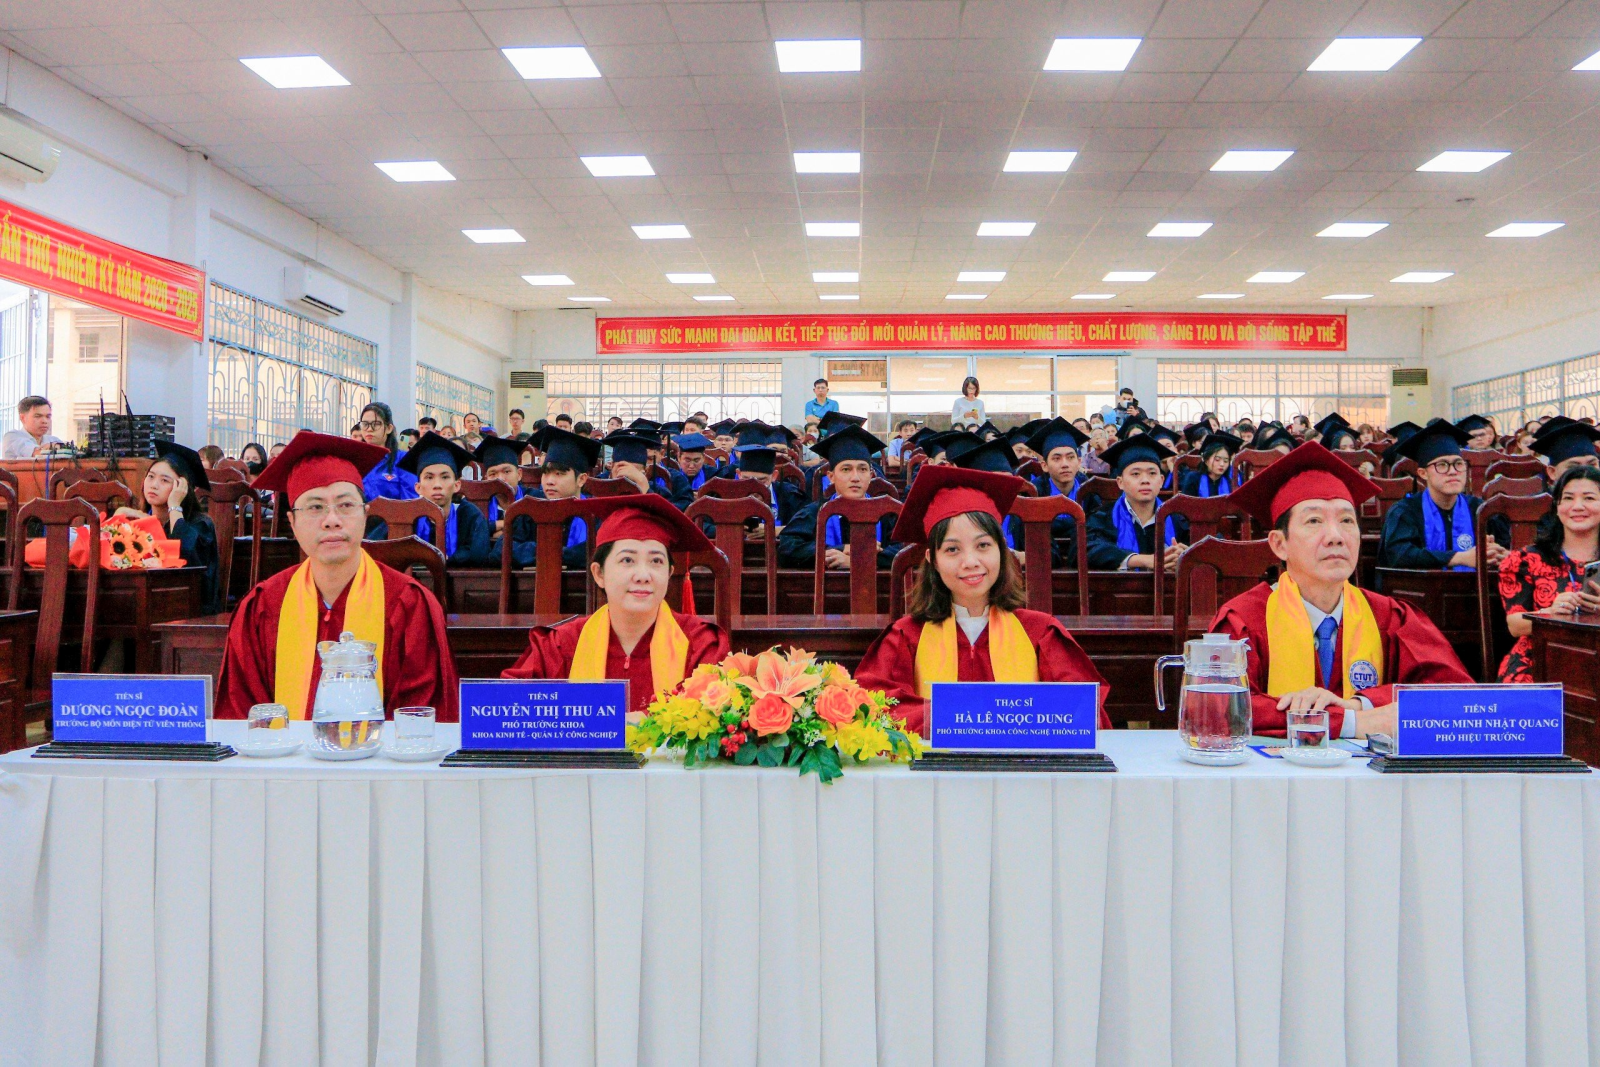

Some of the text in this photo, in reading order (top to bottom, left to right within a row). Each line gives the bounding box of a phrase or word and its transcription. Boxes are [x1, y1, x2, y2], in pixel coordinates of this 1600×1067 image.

[0, 210, 21, 264] ẦN
[25, 231, 53, 280] THƠ,
[57, 243, 96, 293] NHIỆM
[117, 260, 142, 302] NĂM
[144, 275, 167, 313] 2020
[176, 287, 198, 322] 2025
[605, 326, 632, 345] PHÁT
[636, 328, 657, 345] HUY
[660, 325, 682, 344] SỨC
[685, 328, 718, 347] MẠNH
[721, 327, 740, 347] ĐẠI
[743, 323, 772, 343] ĐOÀN
[776, 321, 798, 344] KẾT,
[800, 321, 824, 341] TIẾP
[827, 325, 848, 344] TỤC
[851, 320, 871, 341] ĐỔI
[873, 322, 895, 341] MỚI
[897, 320, 928, 343] QUẢN
[931, 322, 947, 343] LÝ,
[950, 321, 981, 341] NÂNG
[984, 325, 1006, 341] CAO
[1009, 322, 1054, 341] THƯƠNG
[1056, 320, 1085, 344] HIỆU,
[1088, 318, 1117, 341] CHẤT
[1120, 322, 1159, 344] LƯỢNG,
[1163, 321, 1193, 341] SÁNG
[1196, 324, 1217, 344] TẠO
[1220, 321, 1235, 341] VÀ
[1237, 321, 1256, 341] ĐỜI
[1259, 320, 1290, 341] SỐNG
[1292, 322, 1313, 345] TẬP
[1354, 672, 1372, 682] CTUT
[995, 698, 1033, 708] THẠC SĨ
[1463, 704, 1497, 713] TIẾN SĨ
[61, 702, 198, 718] DƯƠNG NGỌC ĐOÀN
[471, 702, 616, 719] NGUYỄN THỊ THU AN
[955, 710, 1073, 725] HÀ LÊ NGỌC DUNG
[502, 720, 520, 729] PHÓ
[560, 721, 585, 729] KHOA
[1401, 718, 1559, 730] TRƯƠNG MINH NHẬT QUANG
[472, 731, 494, 739] KHOA
[495, 731, 515, 739] KINH
[554, 730, 565, 739] LÝ
[565, 730, 588, 739] CÔNG
[588, 730, 618, 740] NGHIỆP
[1030, 728, 1050, 736] NGHỆ
[1435, 732, 1456, 742] PHÓ
[1457, 733, 1482, 743] HIỆU
